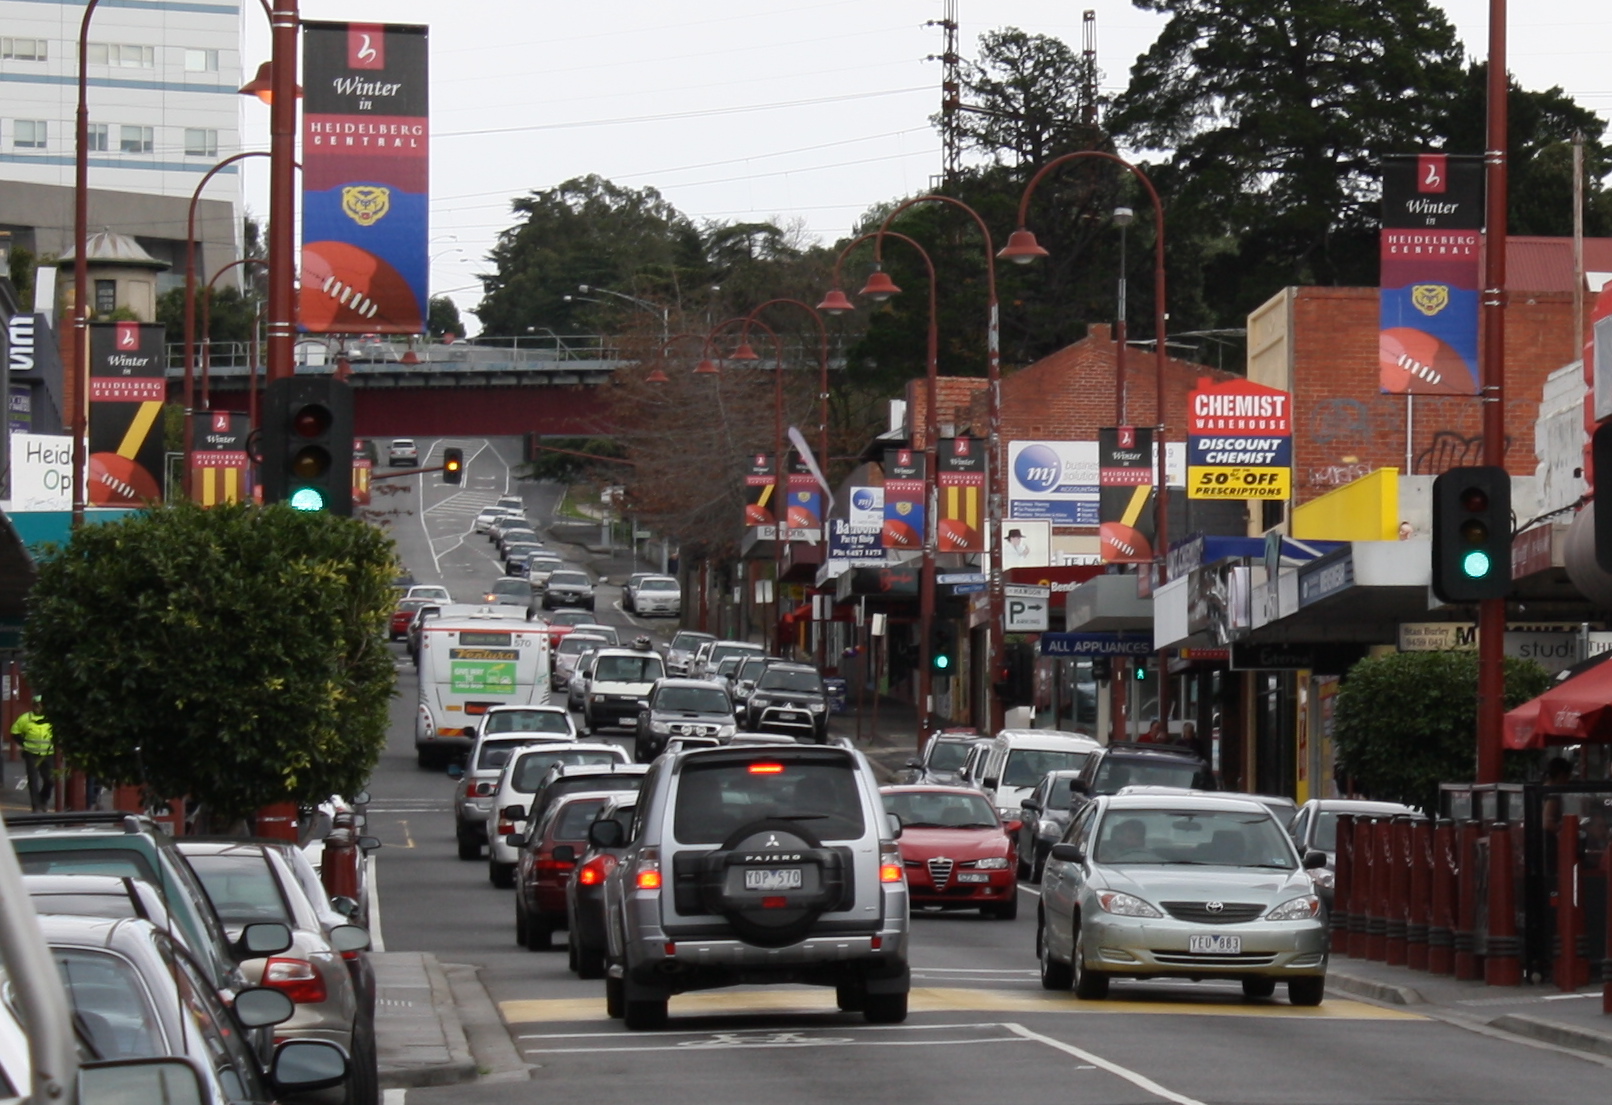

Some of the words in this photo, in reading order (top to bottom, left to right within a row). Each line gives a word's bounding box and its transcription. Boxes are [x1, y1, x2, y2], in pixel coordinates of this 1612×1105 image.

[333, 76, 401, 96] Winter
[359, 97, 372, 110] in
[311, 122, 423, 136] HEIDELBERG
[314, 136, 417, 148] CENTRAL
[1406, 199, 1459, 214] Winter
[1426, 215, 1436, 225] in
[1388, 235, 1475, 245] HEIDELBERG
[1391, 245, 1470, 254] CENTRAL
[107, 355, 149, 367] Winter
[93, 382, 161, 390] HEIDELBERG
[1195, 394, 1286, 417] CHEMIST
[1196, 418, 1286, 429] WAREHOUSE
[206, 435, 236, 444] Winter
[1198, 438, 1282, 451] DISCOUNT
[1112, 450, 1142, 460] Winter
[1206, 452, 1276, 464] CHEMIST
[1027, 462, 1058, 486] mj
[1243, 473, 1279, 485] OFF
[1195, 487, 1282, 496] PRESCRIPTIONS
[1049, 641, 1070, 652] ALL
[1074, 642, 1149, 654] APPLIANCES
[454, 648, 516, 660] Ventura
[1190, 937, 1211, 949] YEU
